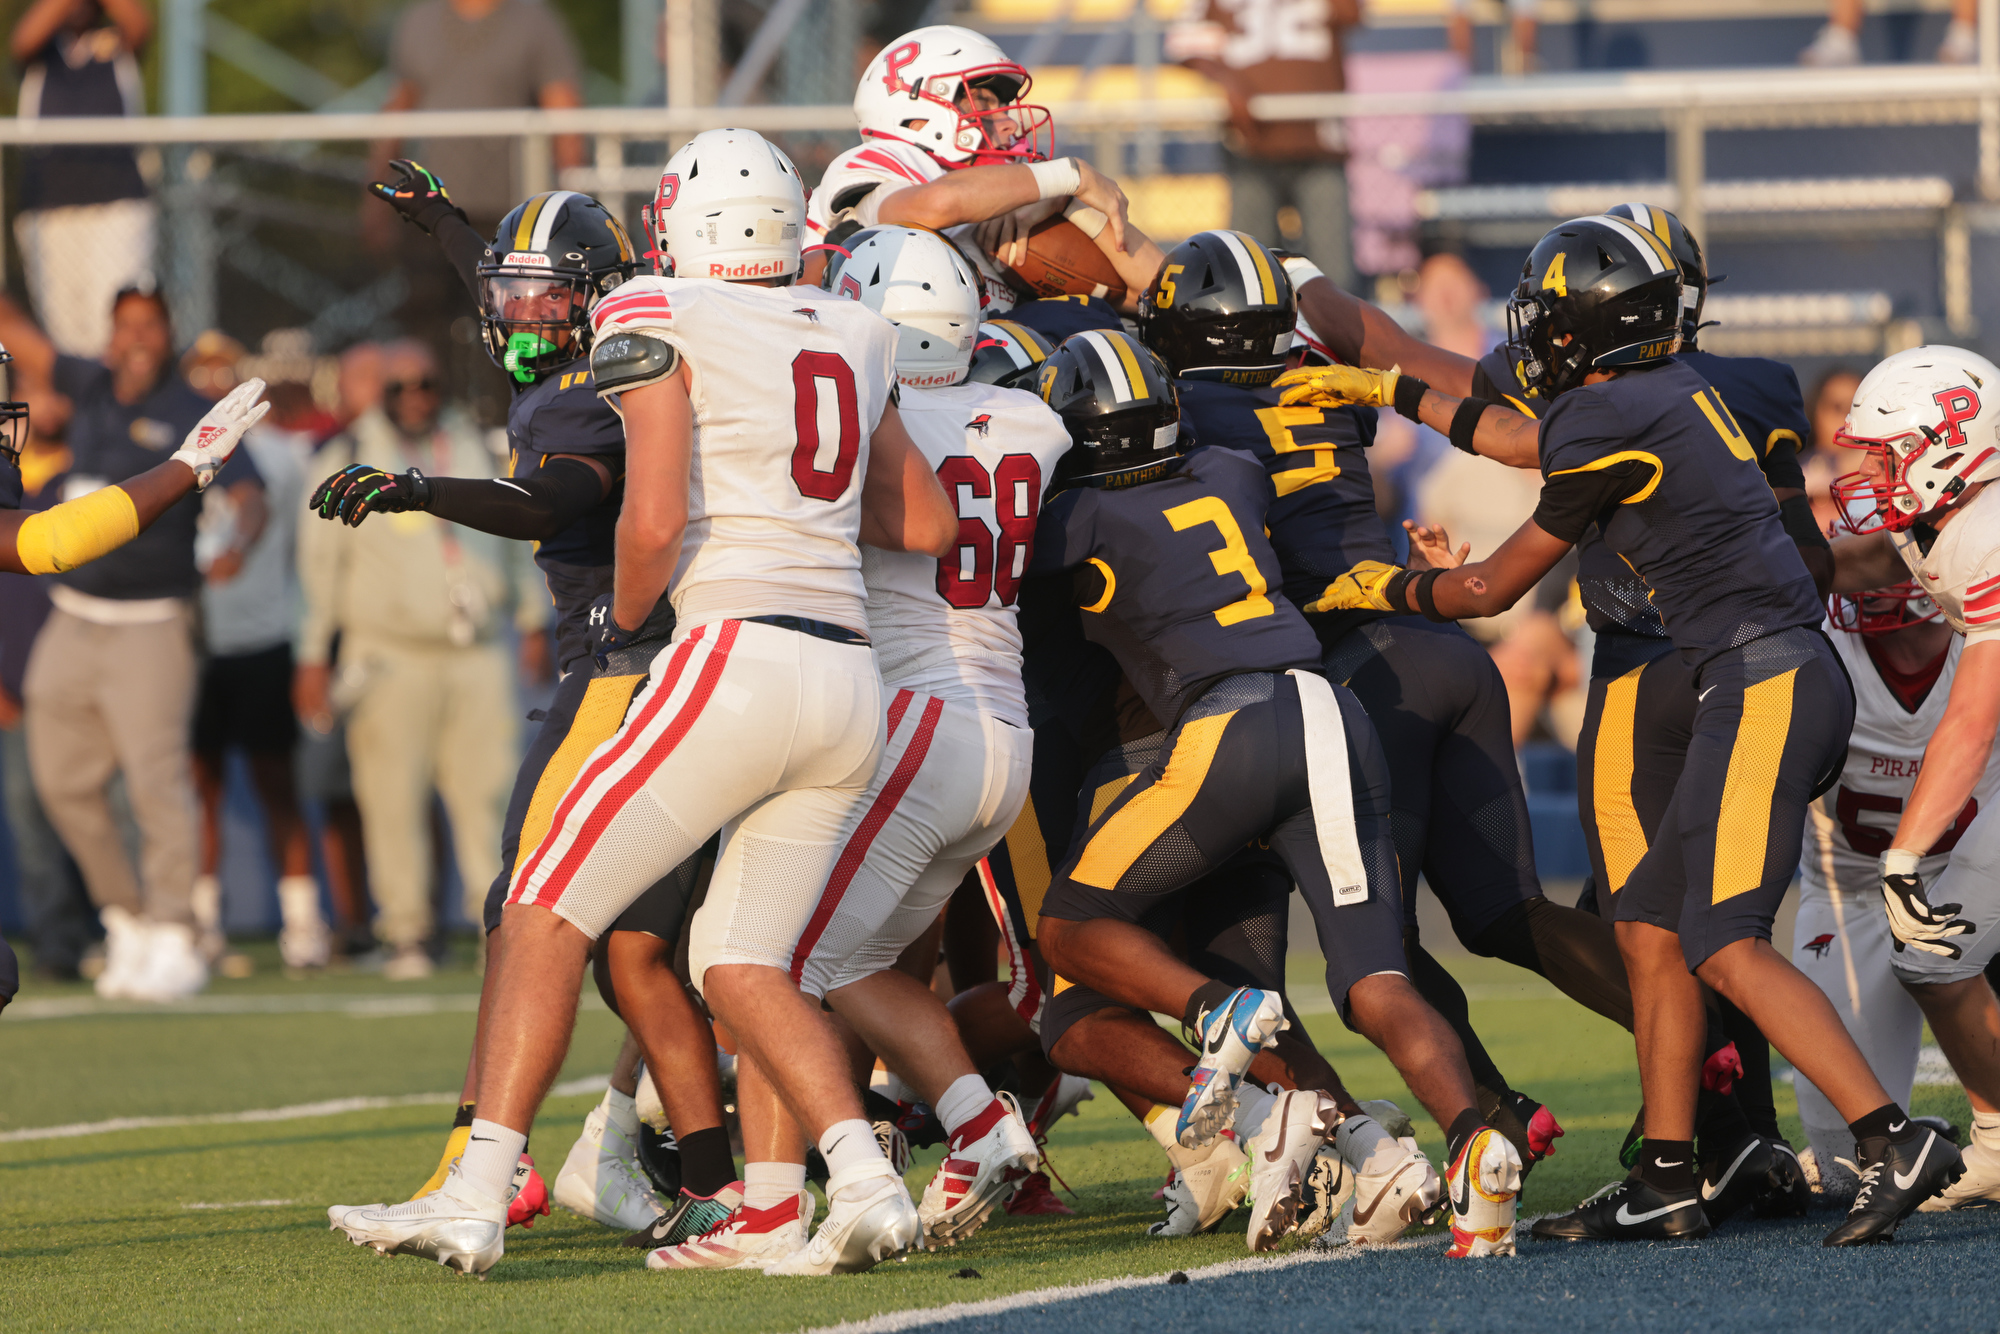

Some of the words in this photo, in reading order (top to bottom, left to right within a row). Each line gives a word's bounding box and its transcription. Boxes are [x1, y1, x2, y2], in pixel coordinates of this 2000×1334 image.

[884, 41, 920, 96] P
[655, 173, 681, 233] P
[508, 254, 545, 265] Riddell
[709, 260, 784, 278] Riddell
[1542, 252, 1567, 297] 4
[1156, 264, 1185, 309] 5
[1038, 366, 1058, 404] 3
[197, 427, 228, 449] adidas
[791, 349, 860, 502] 0
[1932, 385, 1982, 449] P
[1254, 405, 1341, 497] 5
[1105, 463, 1167, 487] PANTHERS
[936, 453, 1041, 609] 68
[1162, 496, 1274, 627] 3
[1870, 756, 1923, 777] PIRA
[515, 1166, 529, 1177] KE
